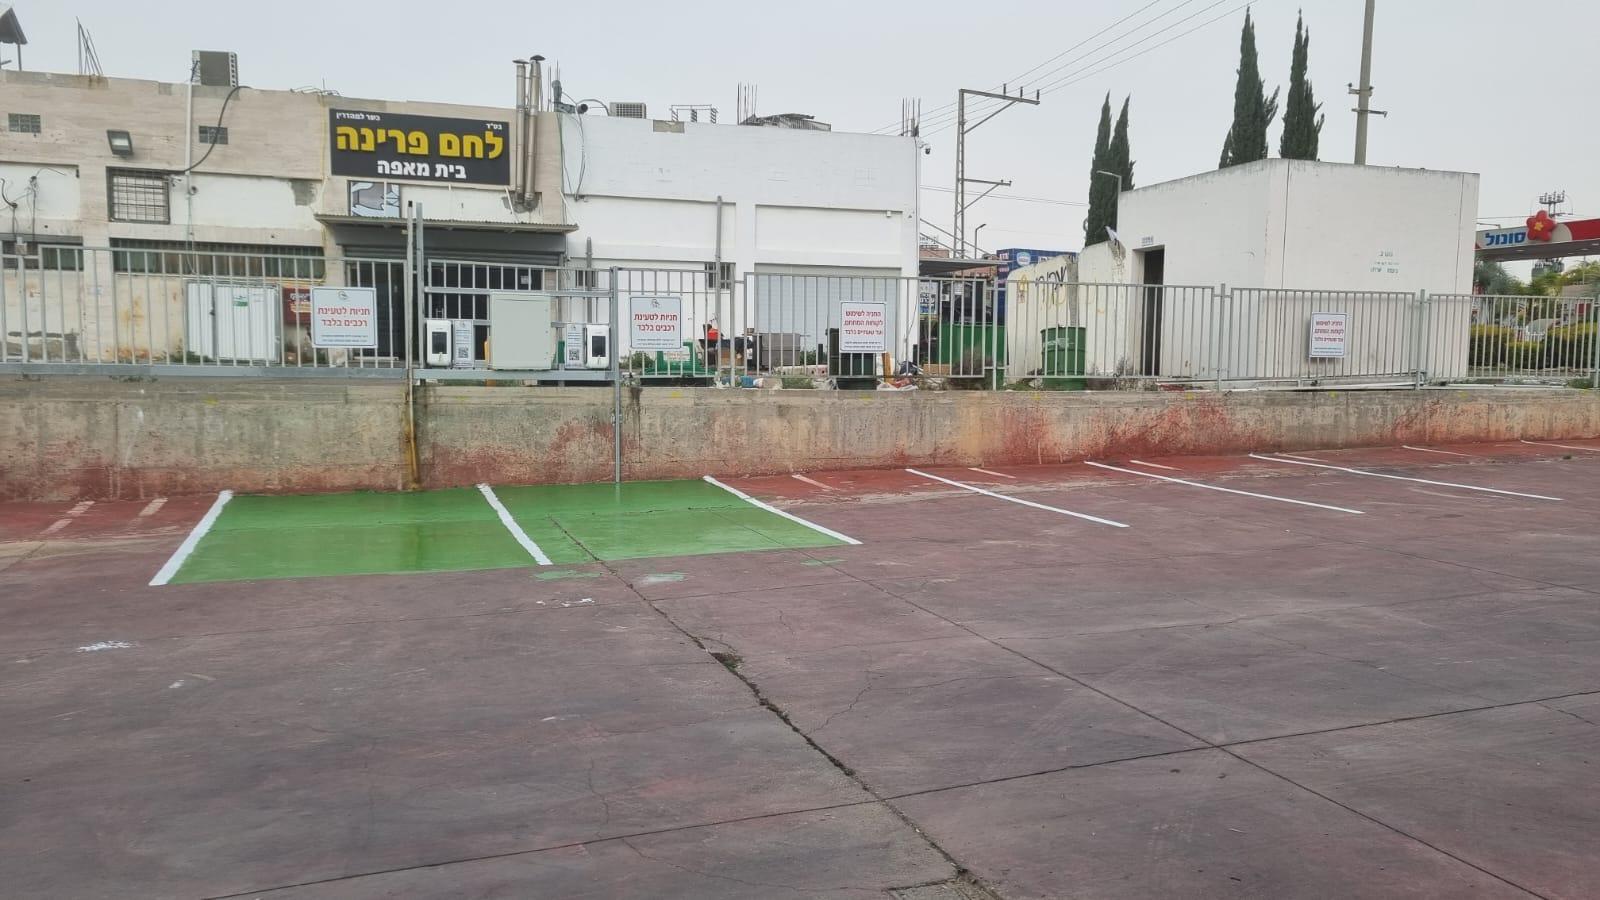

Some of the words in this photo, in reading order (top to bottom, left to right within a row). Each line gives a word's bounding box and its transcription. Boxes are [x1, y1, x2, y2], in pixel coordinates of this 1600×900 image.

[336, 126, 429, 155] פרינה
[439, 131, 503, 159] לחם
[377, 160, 430, 176] מאפה
[435, 163, 467, 179] בית
[1485, 231, 1527, 246] סונול
[318, 306, 347, 315] לטעינת
[350, 307, 371, 316] חניות
[634, 313, 659, 321] לטעינת
[660, 313, 678, 322] חניות
[321, 318, 342, 327] בלבד
[344, 319, 368, 327] רכבים
[636, 323, 654, 331] בלבד
[655, 324, 675, 332] רכבים
